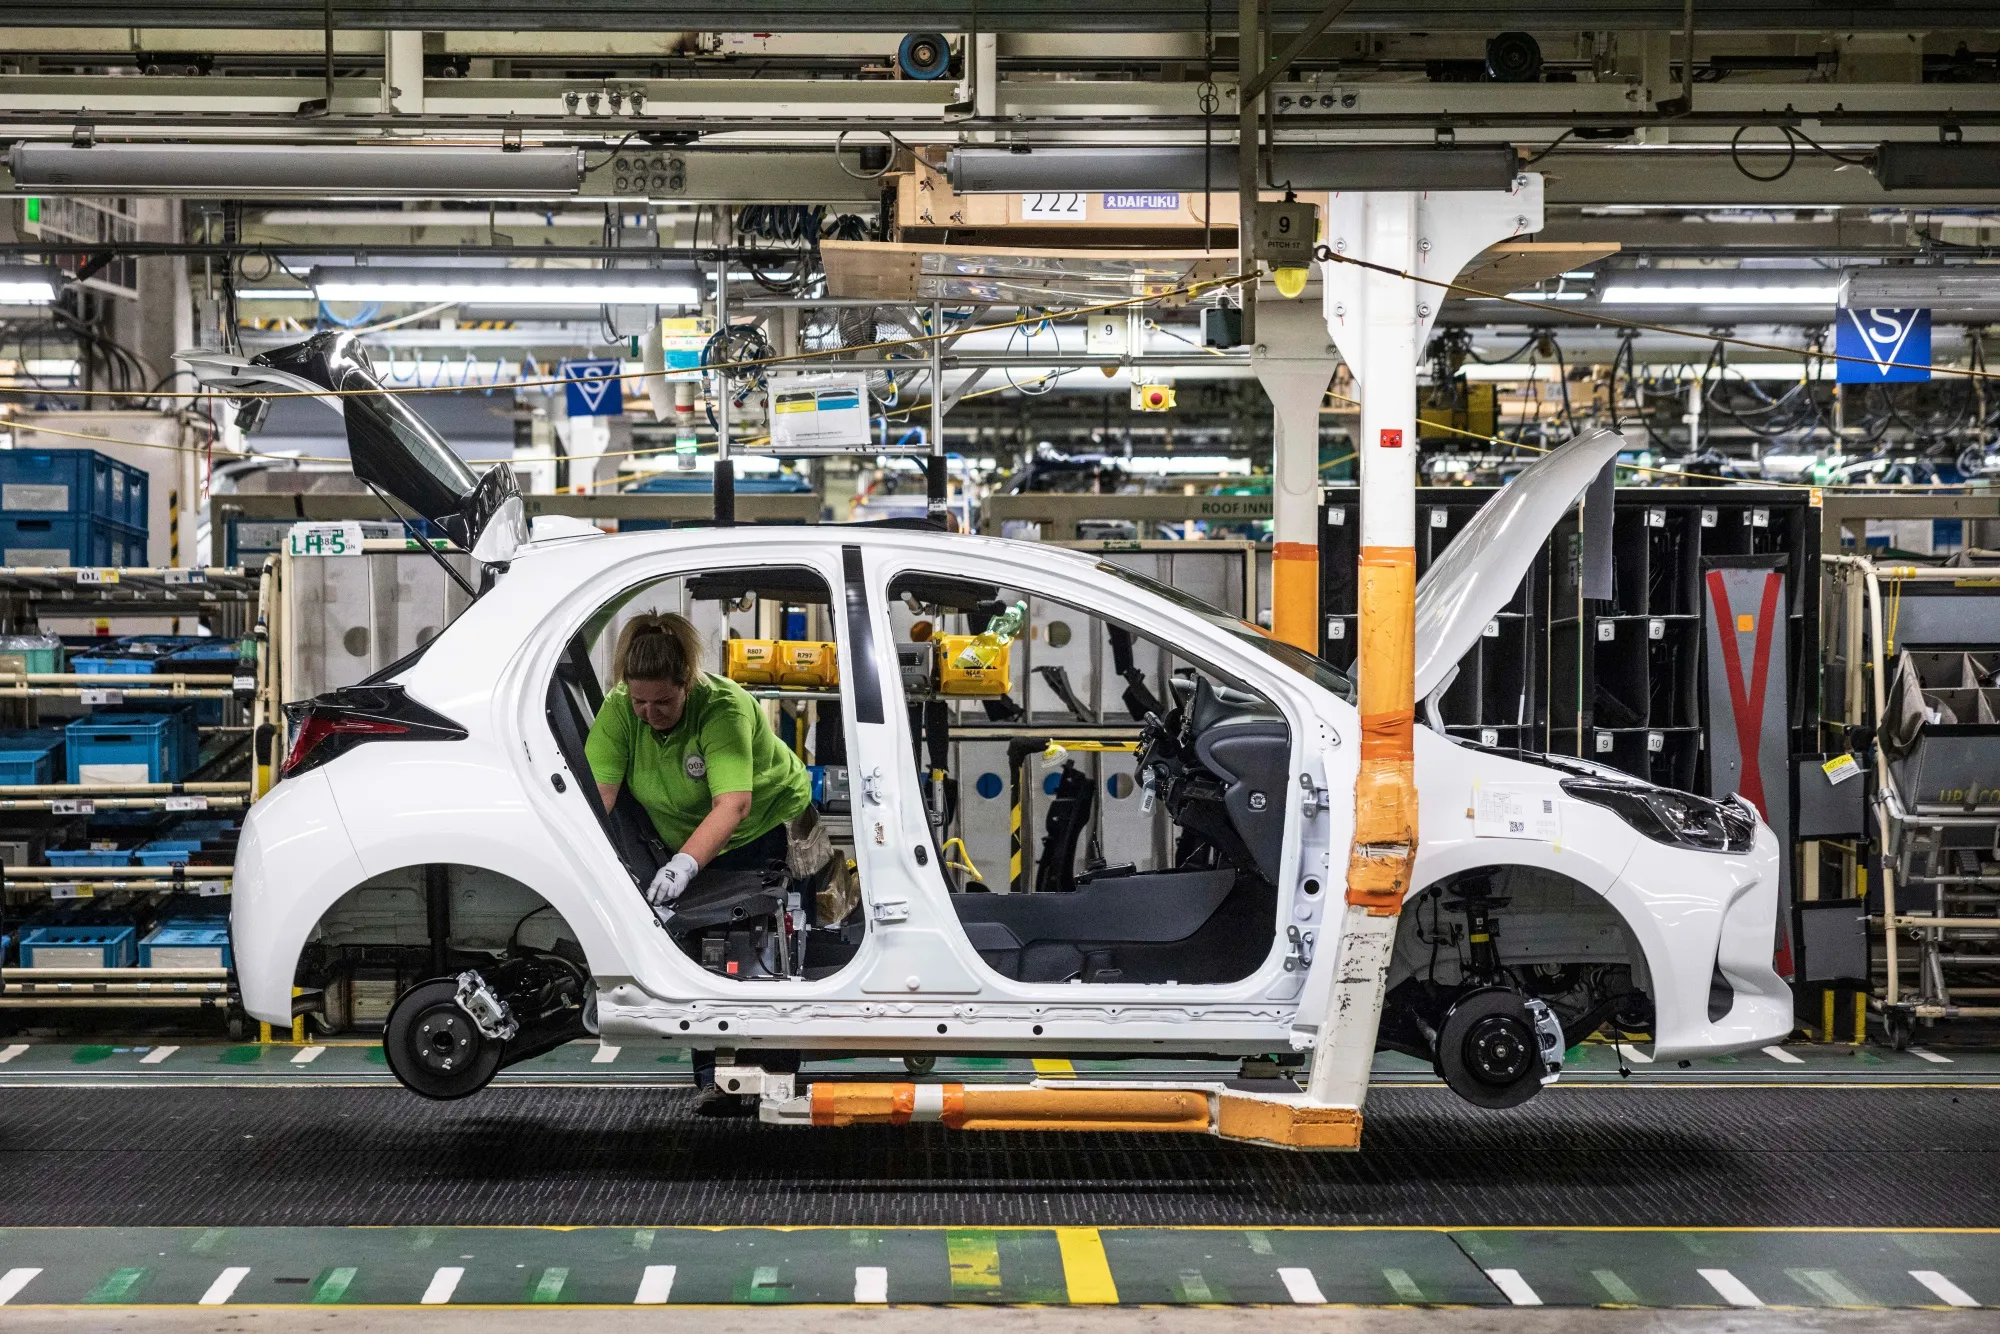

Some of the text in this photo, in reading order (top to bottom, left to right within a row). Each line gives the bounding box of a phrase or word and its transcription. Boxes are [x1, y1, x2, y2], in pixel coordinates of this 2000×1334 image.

[1031, 193, 1078, 212] 222
[1117, 196, 1176, 208] DAIFUKU
[1279, 216, 1290, 233] 9
[1105, 324, 1113, 336] 9
[1868, 308, 1902, 343] S
[583, 367, 603, 393] S
[1811, 490, 1823, 505] 5
[1202, 502, 1239, 514] ROOF
[1335, 512, 1339, 520] 1
[1436, 514, 1442, 523] 3
[1655, 513, 1661, 523] 2
[1706, 514, 1713, 523] 3
[1758, 513, 1765, 522] 4
[292, 533, 345, 554] LH 5
[1334, 627, 1340, 635] 5
[1487, 624, 1494, 633] 8
[1604, 627, 1610, 637] 5
[1654, 626, 1661, 635] 6
[1932, 653, 1939, 662] 4
[1992, 653, 1999, 662] 5
[1949, 689, 1955, 698] 1
[1485, 735, 1495, 744] 12
[1602, 739, 1609, 749] 9
[1651, 738, 1661, 748] 10
